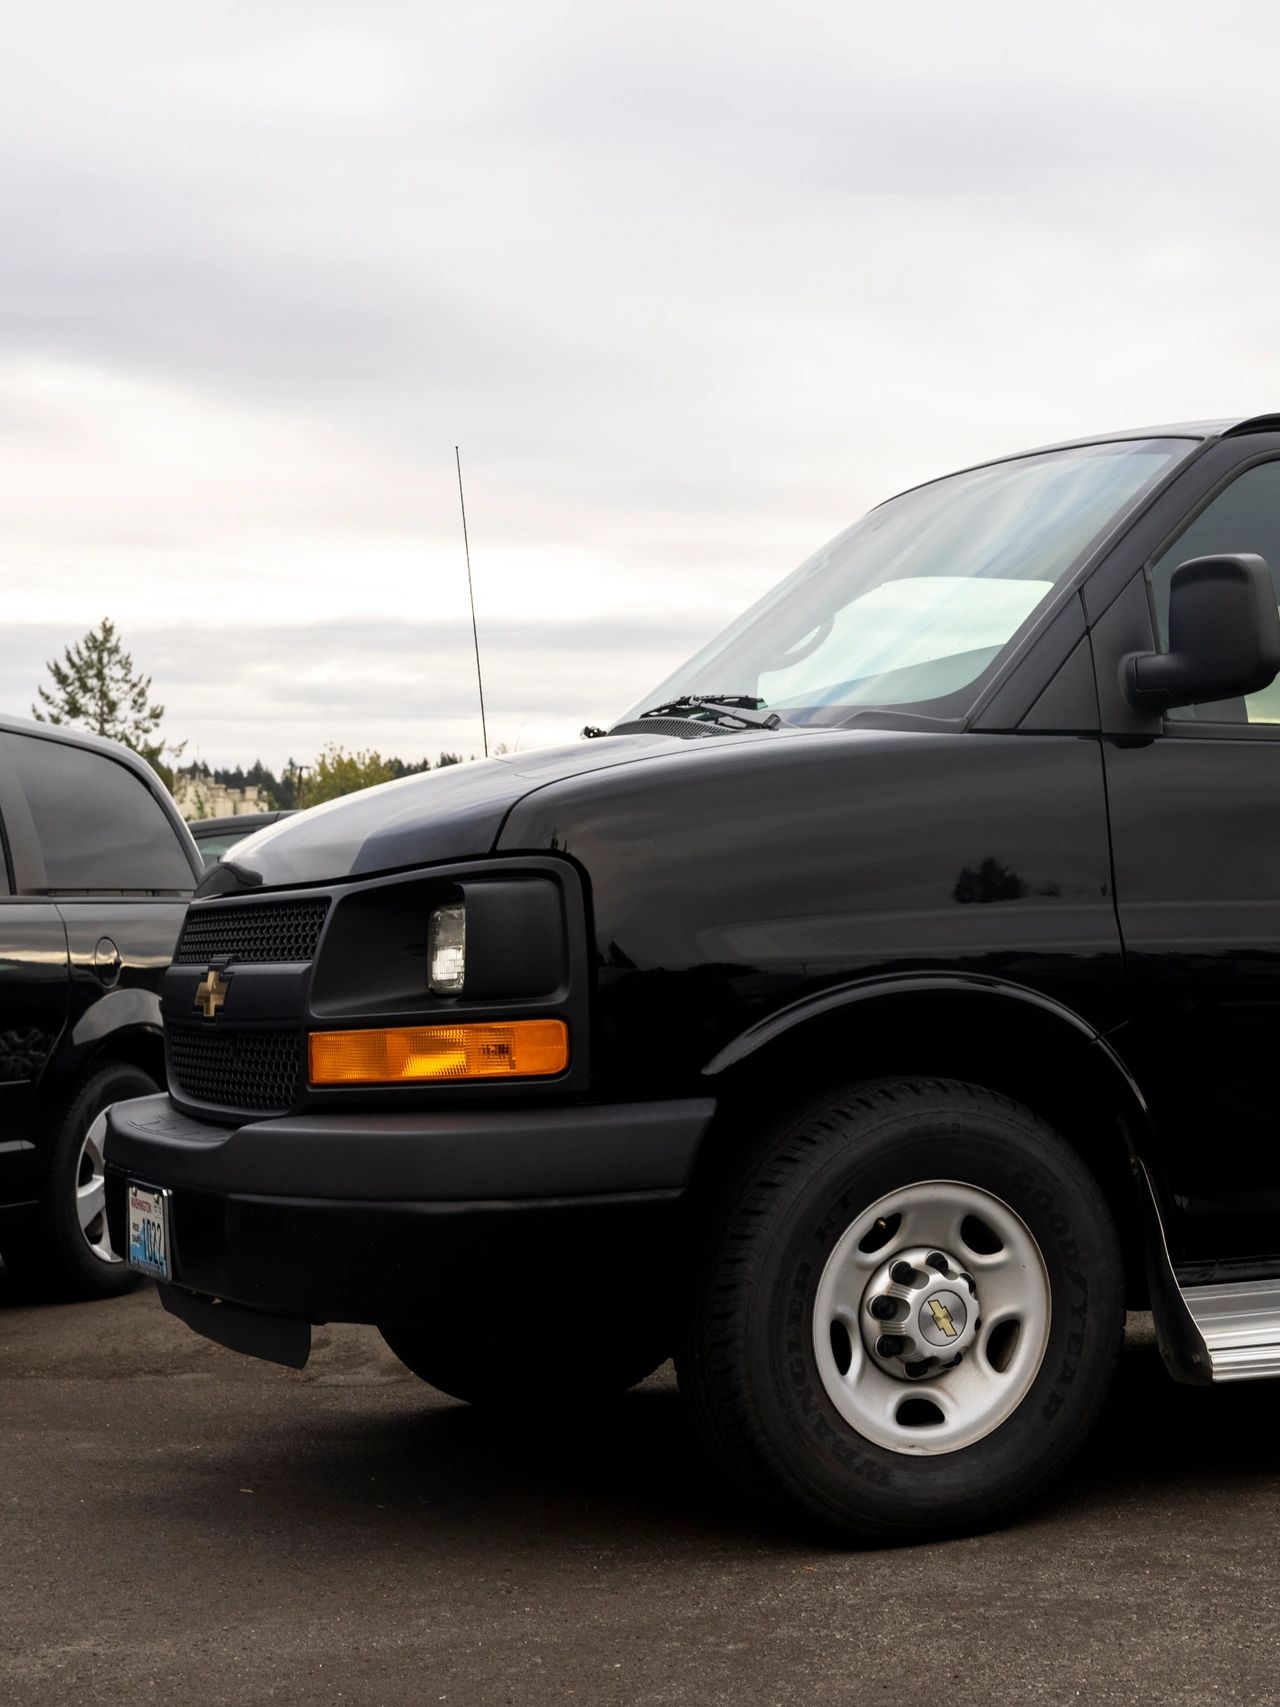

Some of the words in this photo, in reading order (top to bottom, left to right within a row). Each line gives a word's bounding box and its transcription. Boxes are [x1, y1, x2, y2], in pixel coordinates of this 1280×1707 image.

[131, 1197, 151, 1214] WASHINGTON
[143, 1218, 163, 1266] 1022
[1010, 1171, 1089, 1421] GOODYEAR
[786, 1261, 892, 1487] WRANGLER
